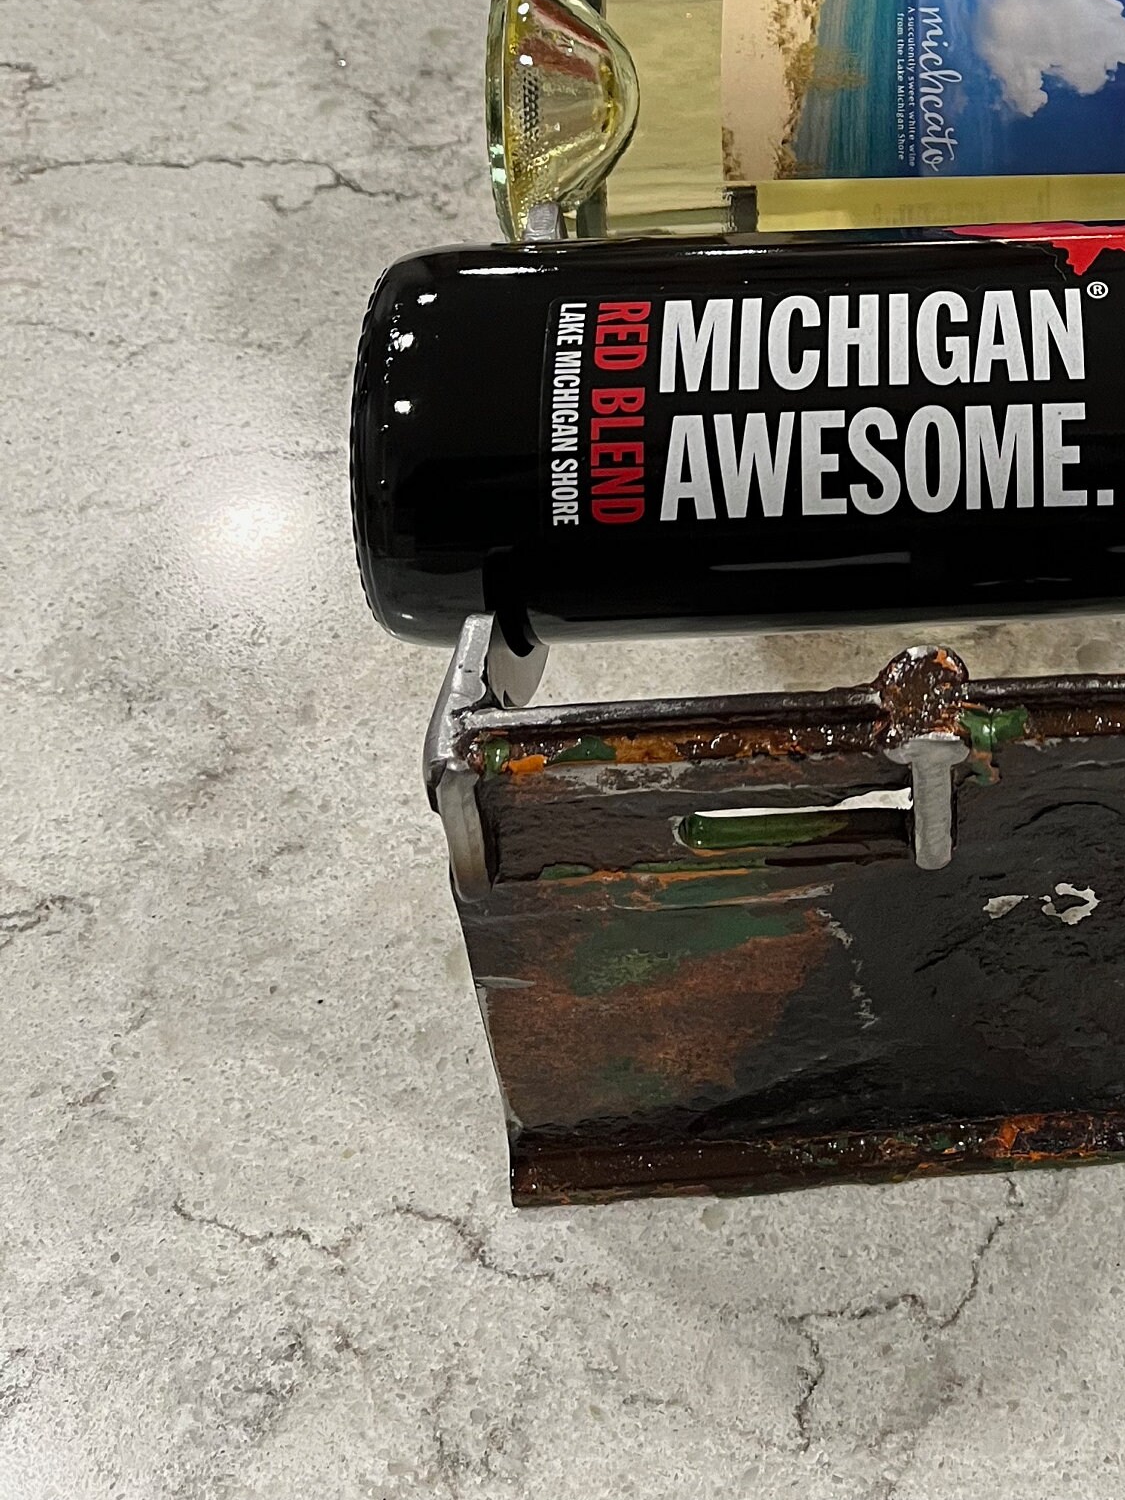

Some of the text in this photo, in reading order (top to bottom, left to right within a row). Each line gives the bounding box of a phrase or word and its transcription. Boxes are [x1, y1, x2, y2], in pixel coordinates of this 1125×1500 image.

[906, 16, 916, 72] succulently
[907, 6, 916, 14] A
[896, 13, 905, 160] from the Lake Michigan Shore
[908, 111, 916, 140] white
[918, 7, 963, 172] michcato
[909, 144, 917, 167] wine
[551, 302, 588, 526] LAKE MICHIGAN SHORE
[590, 301, 651, 524] RED BLEND
[660, 402, 1114, 521] AWESOME.
